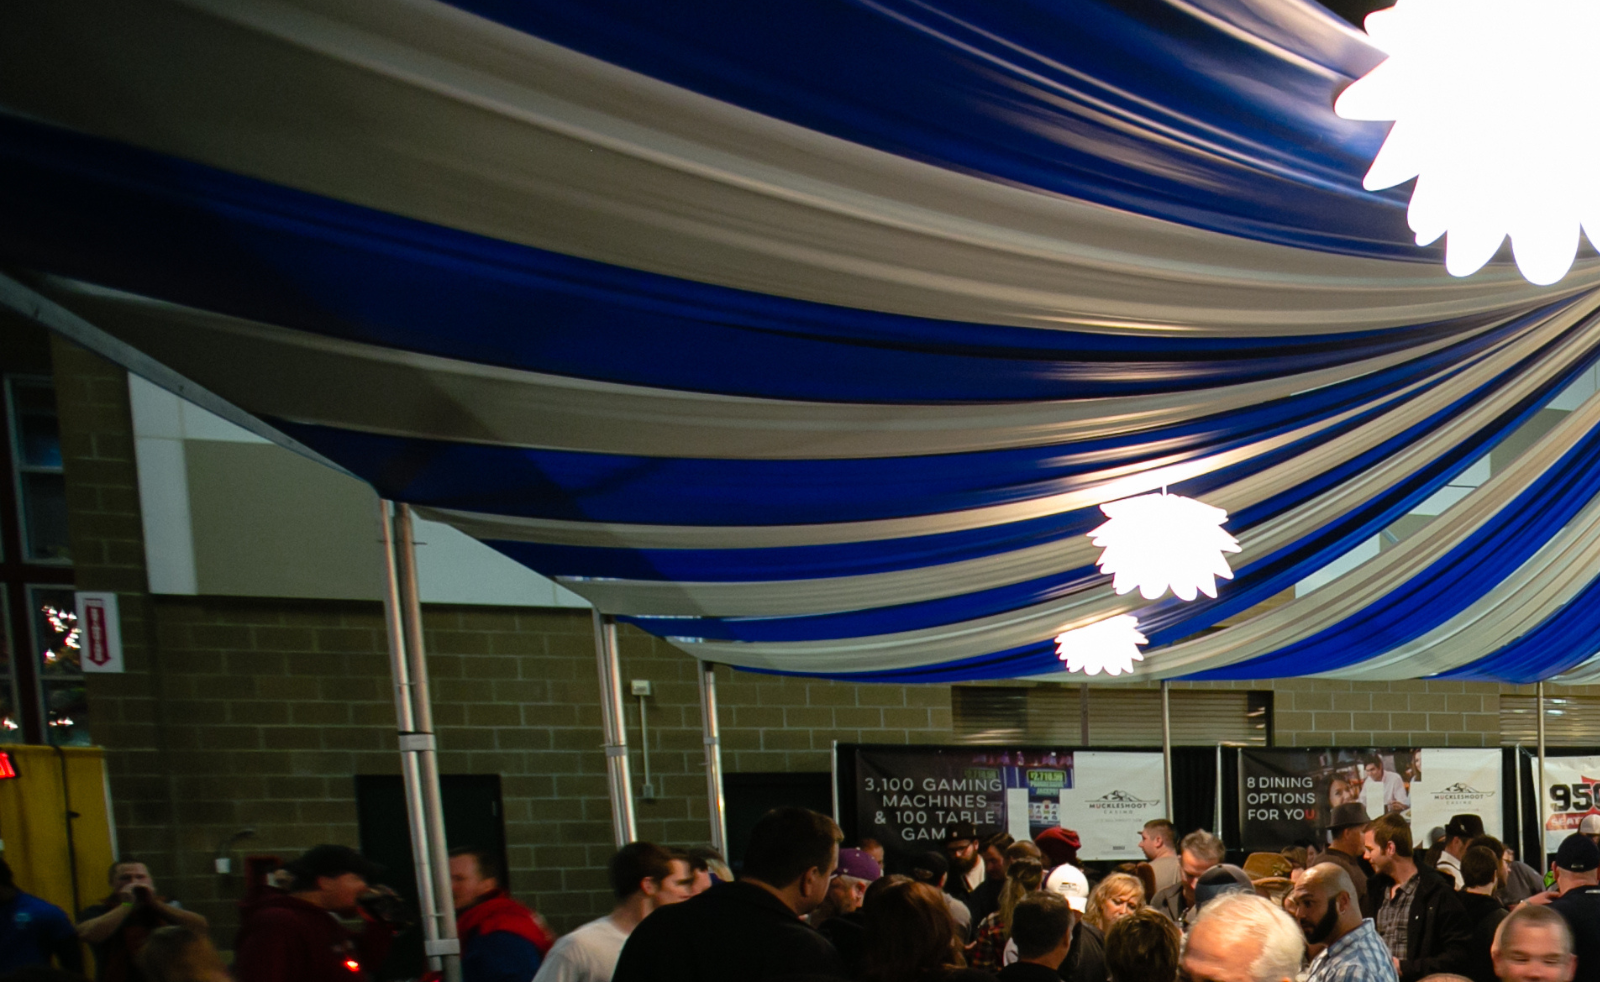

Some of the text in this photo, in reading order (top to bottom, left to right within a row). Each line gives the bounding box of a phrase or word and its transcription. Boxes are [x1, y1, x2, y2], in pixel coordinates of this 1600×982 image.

[864, 777, 1002, 792] 3,100 GAMING
[1246, 776, 1314, 788] 8 DINING
[882, 794, 987, 808] MACHINES
[1246, 792, 1316, 805] OPTIONS
[874, 810, 996, 824] & 100 TABLE
[1248, 808, 1316, 820] FOR YOU
[901, 827, 947, 841] GAM
